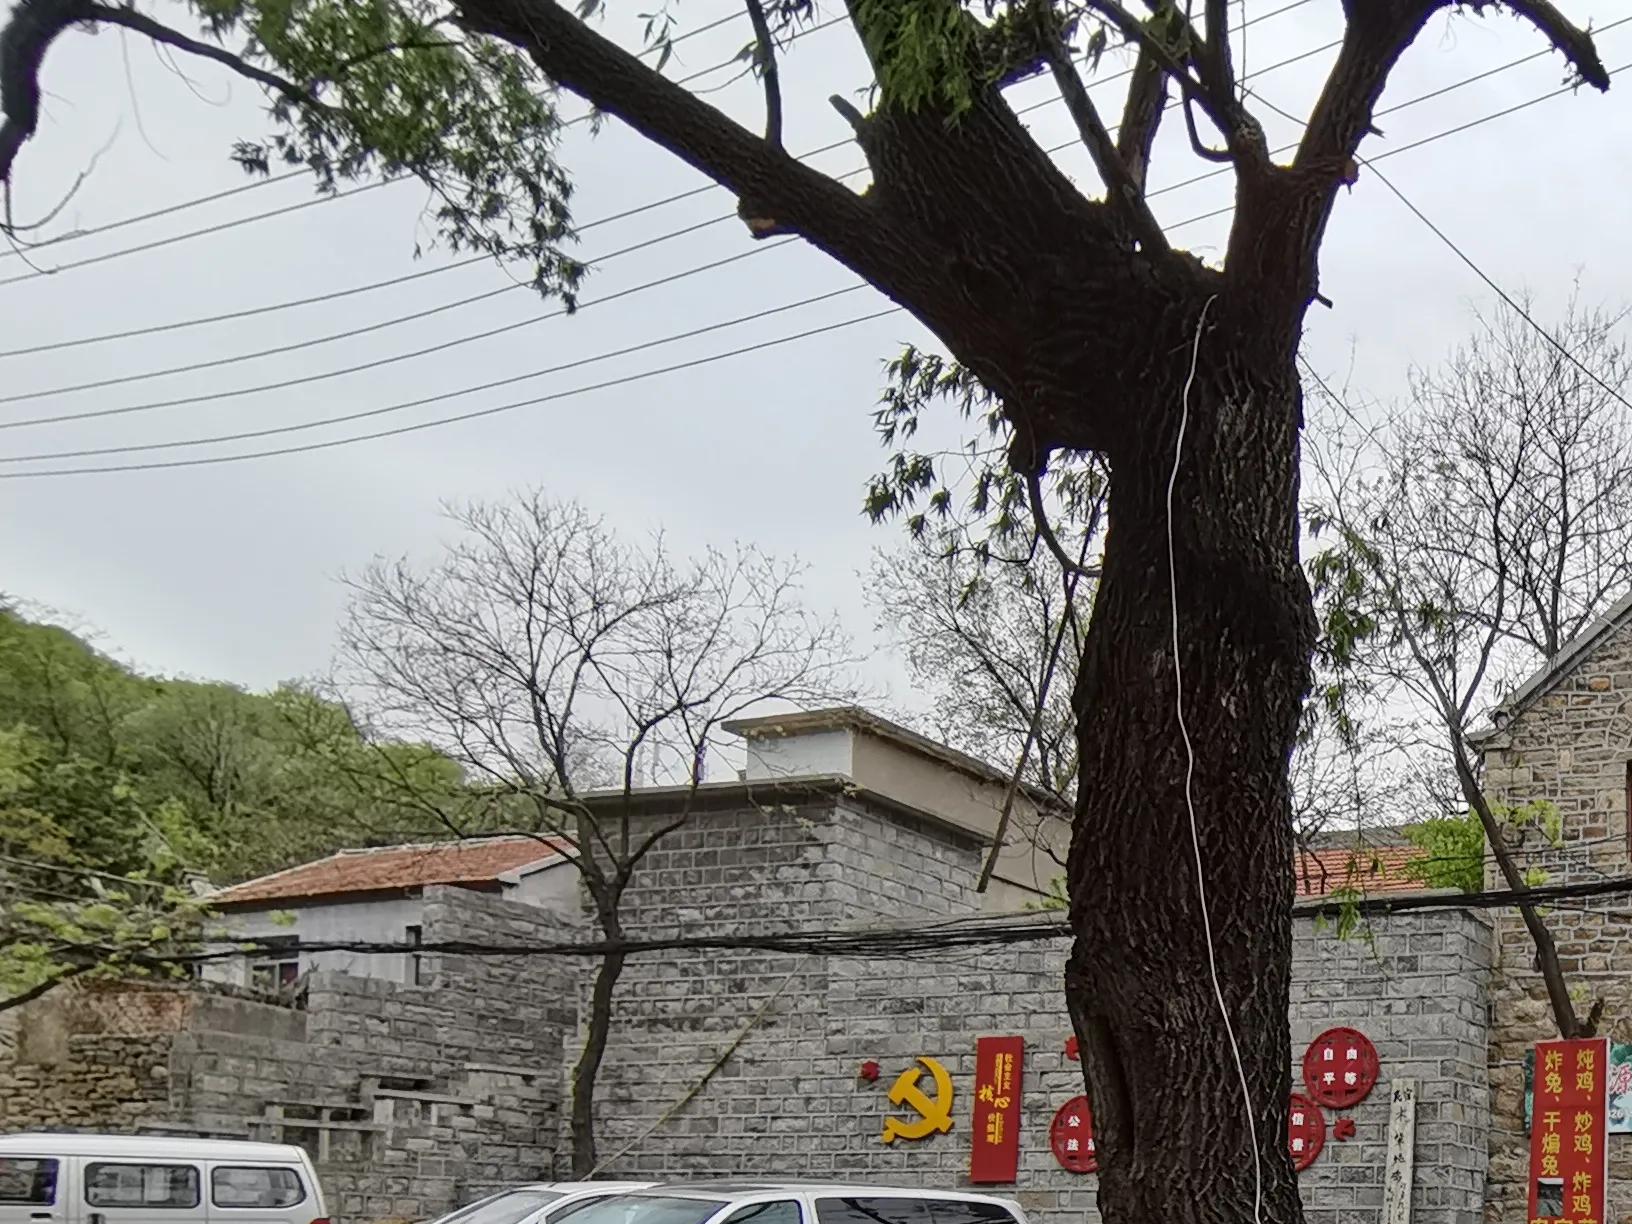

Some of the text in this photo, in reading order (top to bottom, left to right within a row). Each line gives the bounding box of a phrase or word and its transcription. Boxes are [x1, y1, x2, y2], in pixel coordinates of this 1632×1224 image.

[1323, 1047, 1358, 1061] 自由
[1322, 1071, 1357, 1086] 平等
[978, 1083, 1011, 1109] 核心
